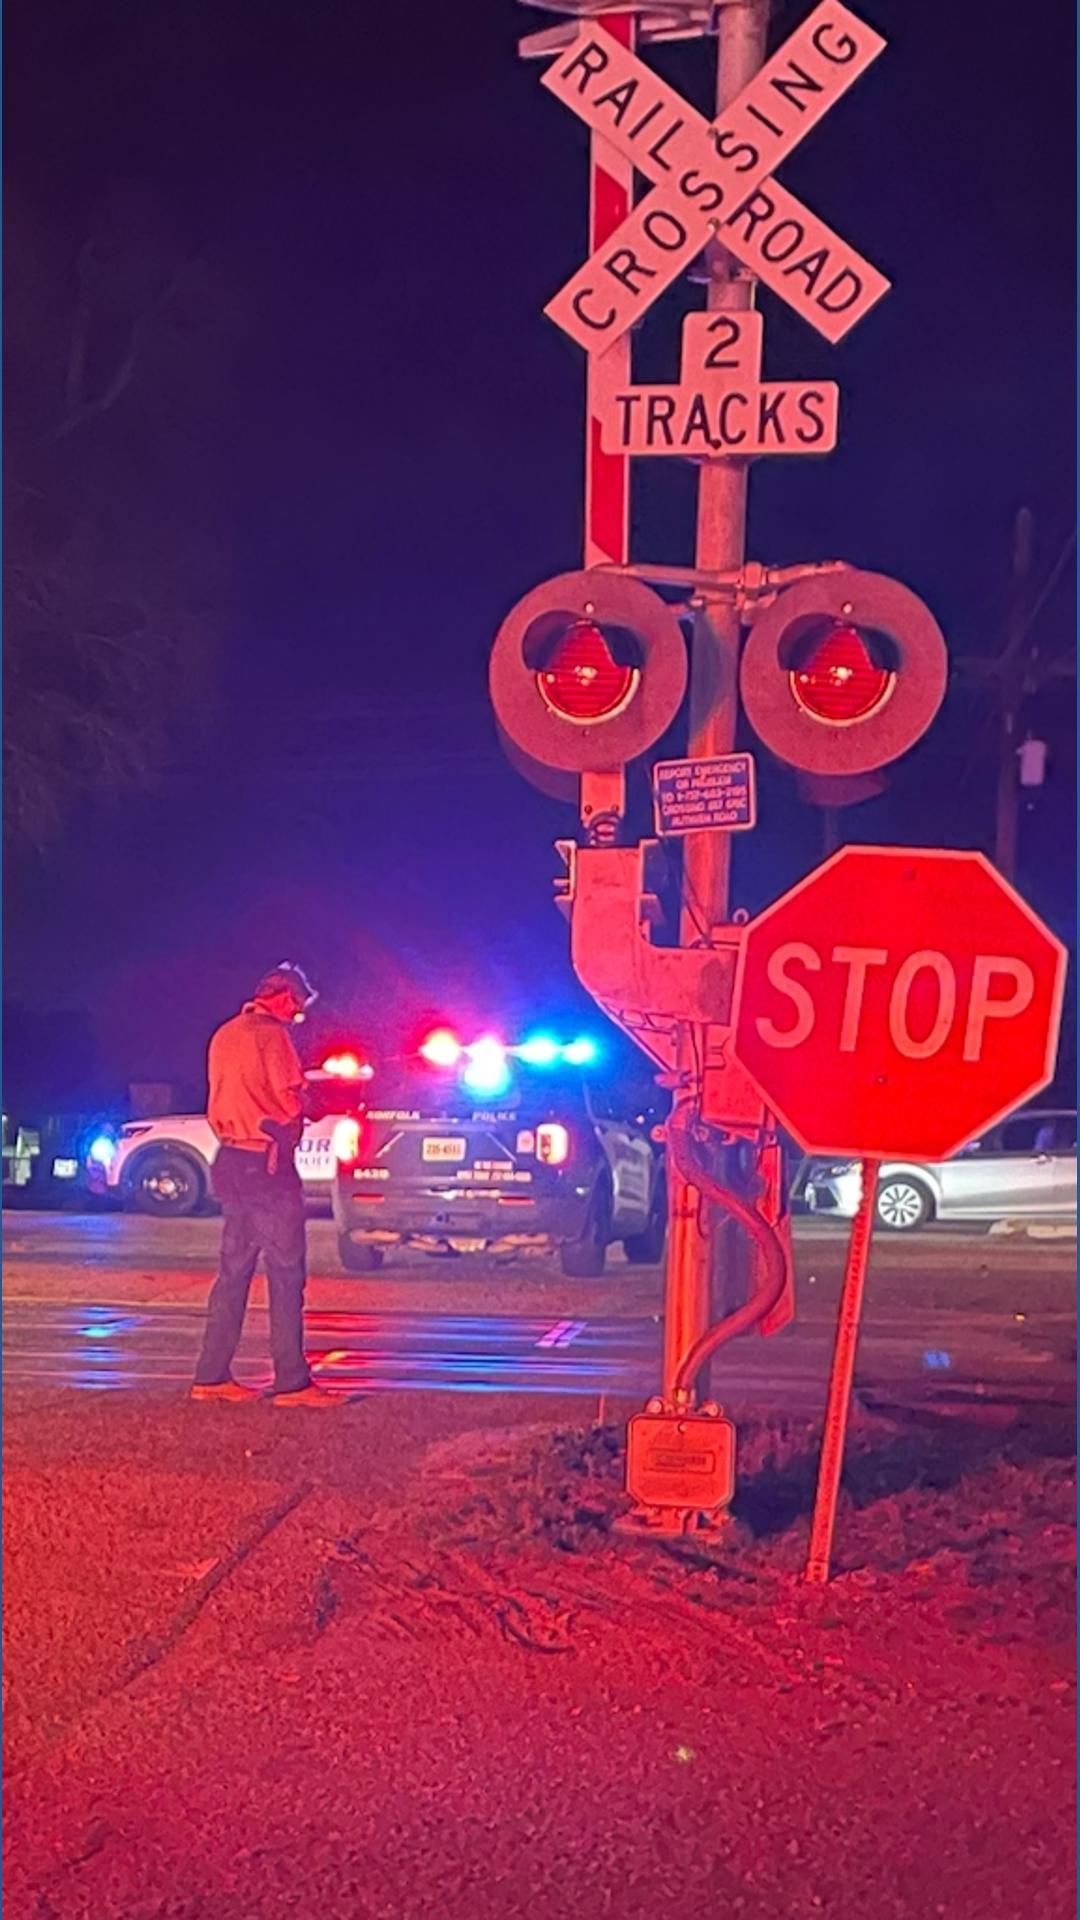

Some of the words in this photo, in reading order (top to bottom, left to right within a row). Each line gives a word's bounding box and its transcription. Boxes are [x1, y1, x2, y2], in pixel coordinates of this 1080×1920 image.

[560, 41, 685, 172] RAIL
[726, 188, 862, 314] ROAD
[572, 22, 858, 331] CROSSING
[704, 316, 741, 369] 2
[615, 390, 825, 447] TRACKS
[754, 941, 1036, 1063] STOP
